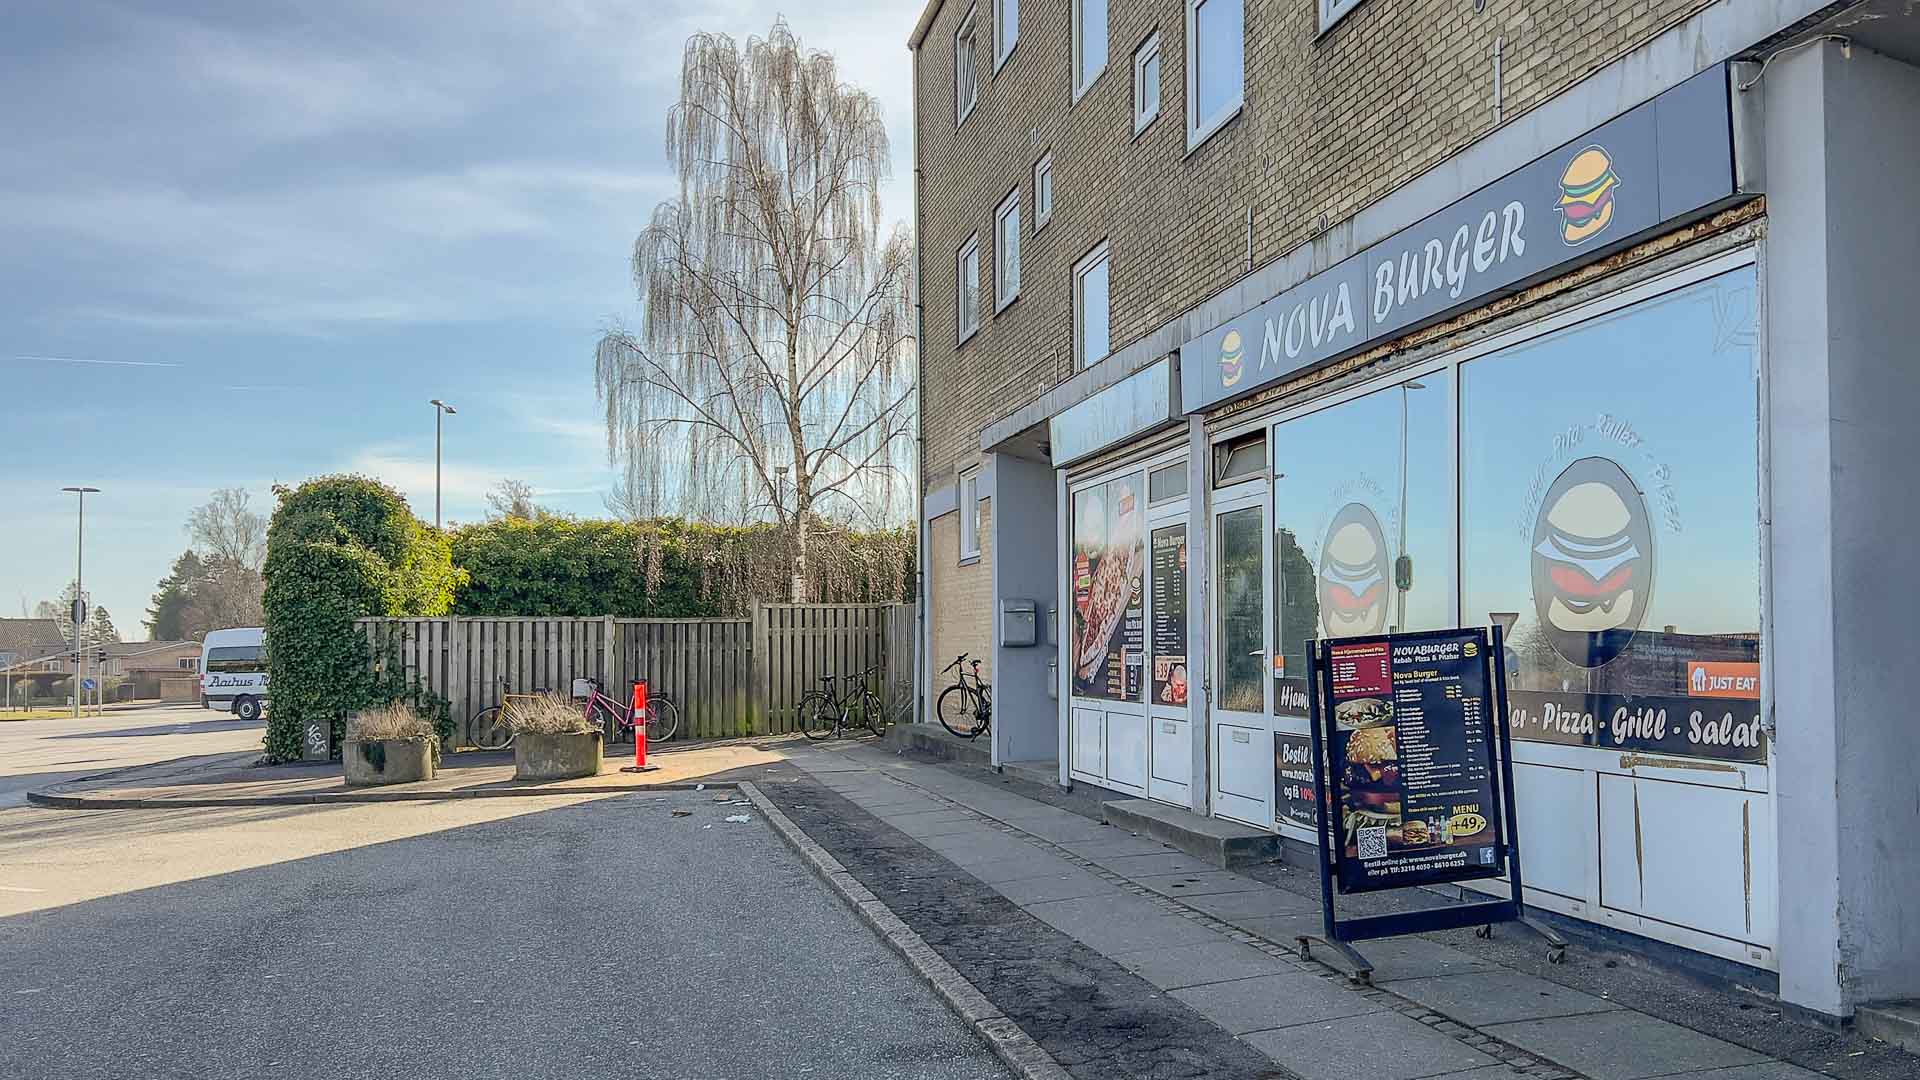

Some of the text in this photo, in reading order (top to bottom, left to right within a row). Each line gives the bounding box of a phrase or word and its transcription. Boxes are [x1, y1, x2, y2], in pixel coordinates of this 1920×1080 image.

[1259, 200, 1526, 371] NOVA BURGER
[1170, 535, 1185, 548] Burger
[1393, 643, 1459, 656] NOVABURGER
[208, 675, 253, 687] Aarhus
[1414, 670, 1438, 679] Burger
[1709, 676, 1757, 690] JUST EAT
[1281, 686, 1309, 711] Hjem
[1543, 703, 1760, 747] Pizza Grill Salat
[1283, 744, 1308, 764] Bestil
[1281, 768, 1313, 782] www.novab
[1453, 804, 1479, 815] MENU
